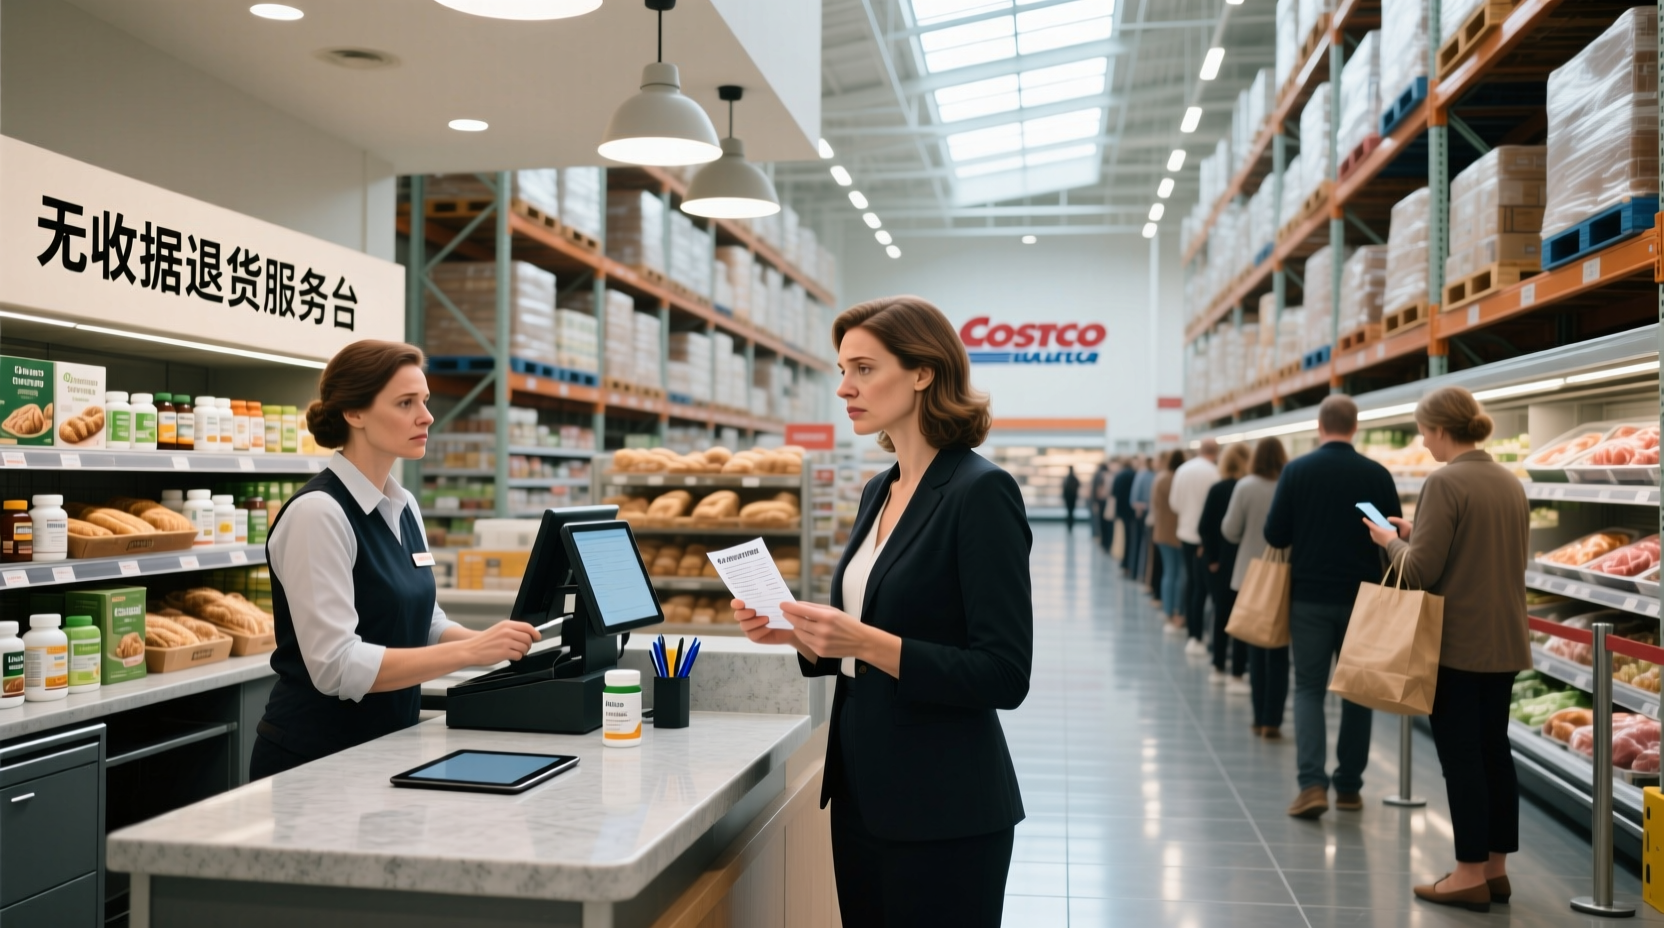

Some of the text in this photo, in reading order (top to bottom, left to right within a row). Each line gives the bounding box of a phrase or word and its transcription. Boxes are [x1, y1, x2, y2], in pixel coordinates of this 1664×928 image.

[37, 194, 358, 332] 无收据退货服务台
